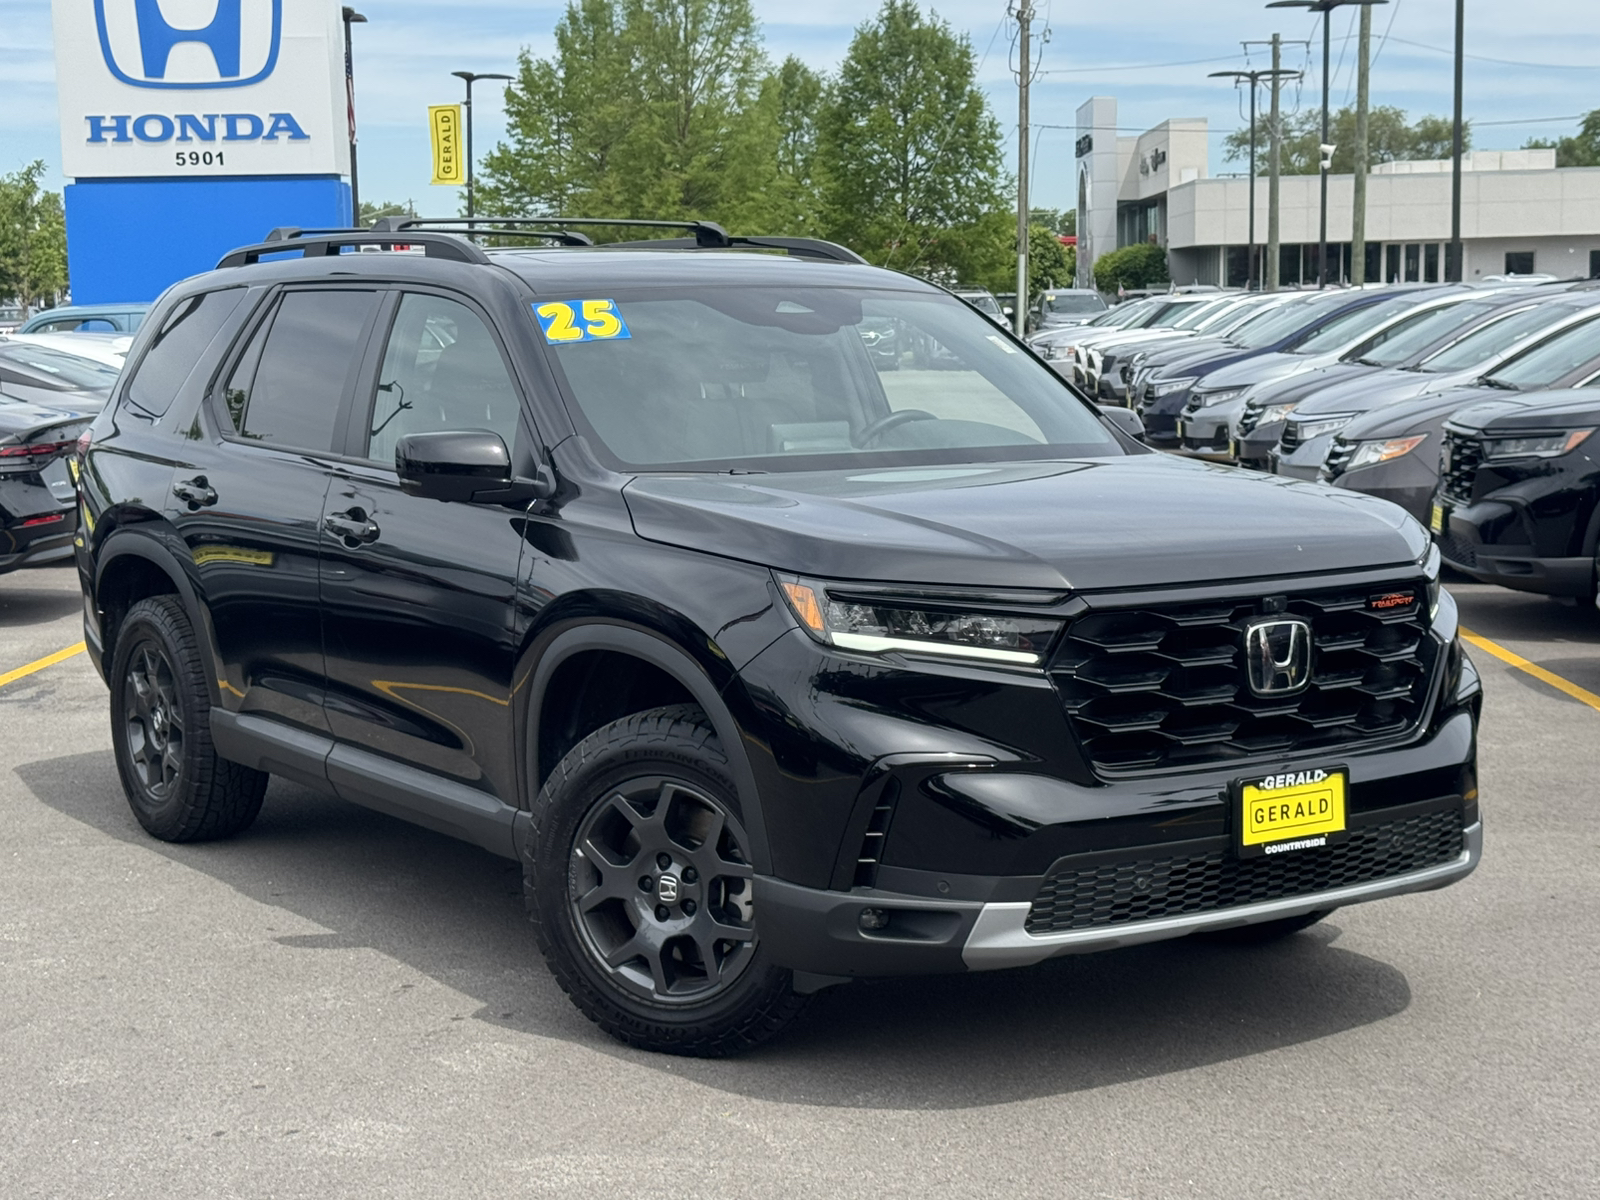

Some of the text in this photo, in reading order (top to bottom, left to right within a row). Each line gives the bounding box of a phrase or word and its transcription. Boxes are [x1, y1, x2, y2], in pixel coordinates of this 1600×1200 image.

[84, 113, 311, 143] HONDA
[440, 115, 452, 174] GERALD
[175, 151, 225, 166] 5901
[537, 300, 622, 341] 25
[1264, 769, 1324, 790] GERALD
[1254, 798, 1328, 824] GERALD
[1264, 837, 1326, 855] COUNTRYSIDE
